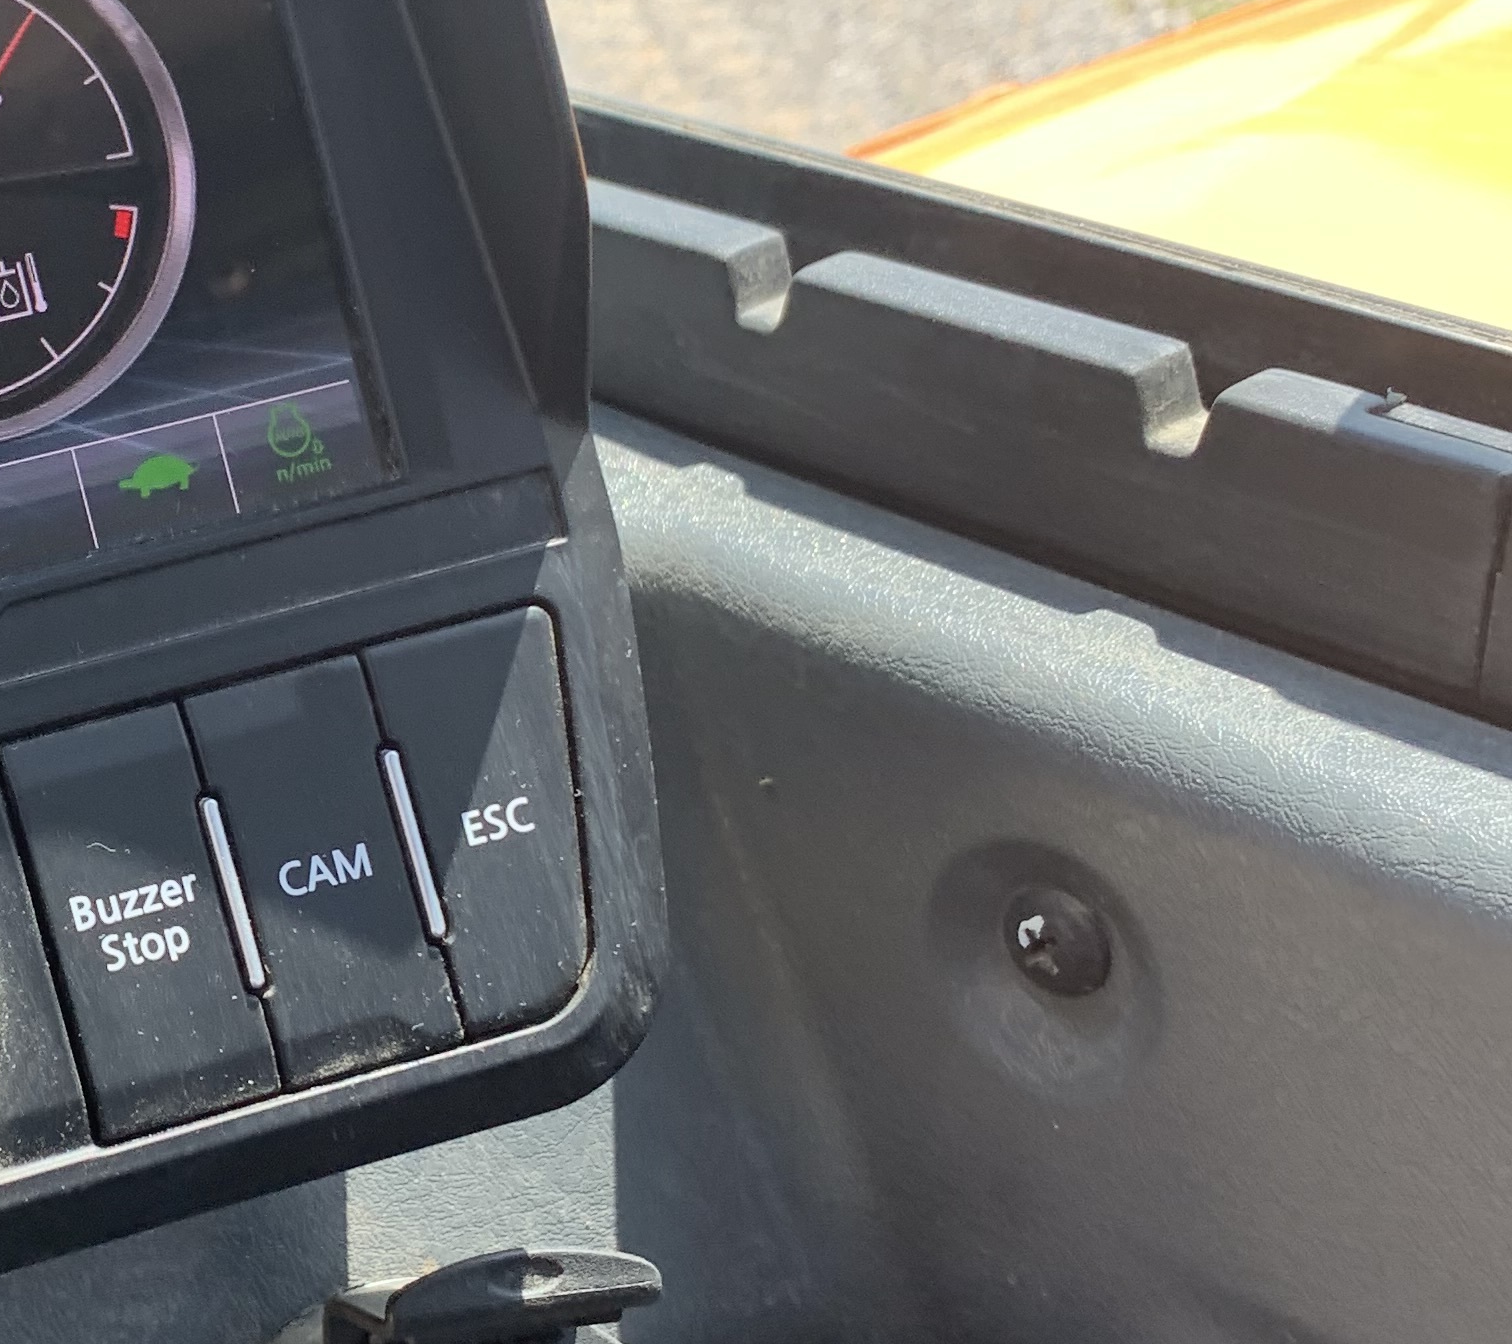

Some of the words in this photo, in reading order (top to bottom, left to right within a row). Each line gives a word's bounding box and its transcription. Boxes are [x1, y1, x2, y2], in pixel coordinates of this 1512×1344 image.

[461, 797, 535, 847] ESC
[279, 842, 373, 897] CAM
[69, 873, 197, 933] Buzzer
[101, 923, 190, 973] Stop
